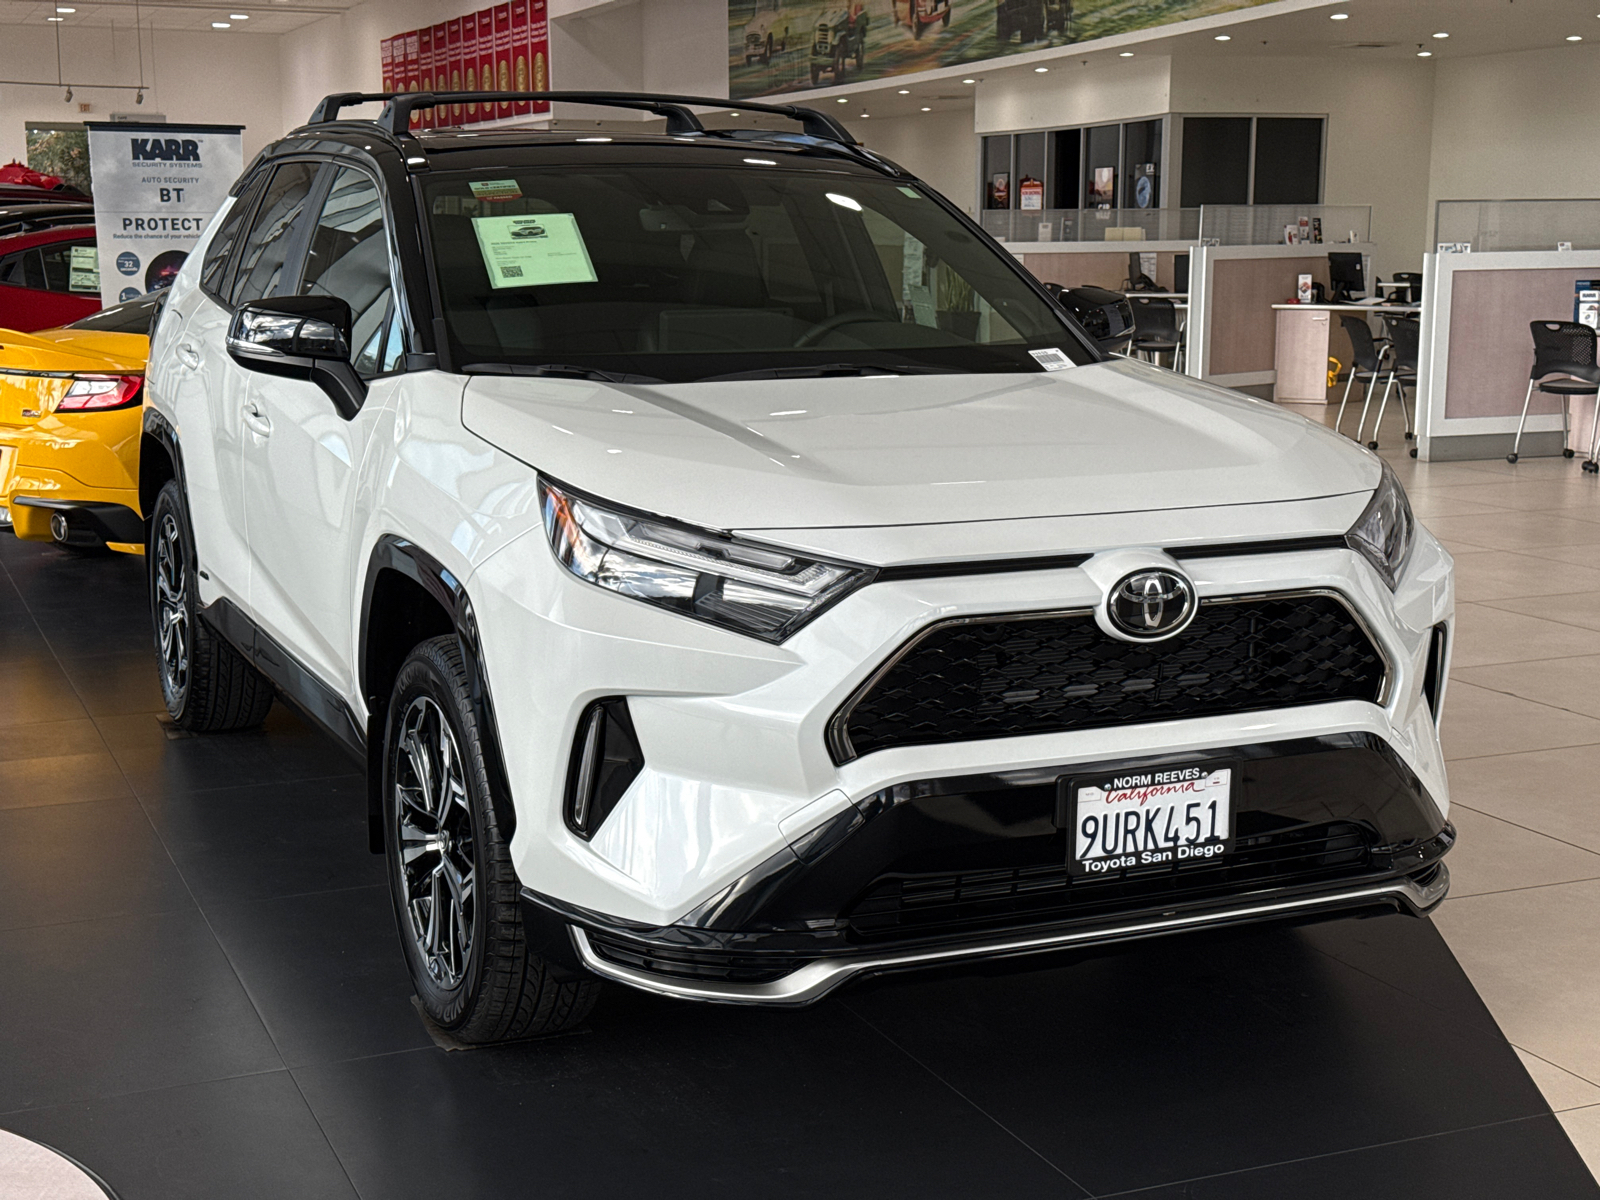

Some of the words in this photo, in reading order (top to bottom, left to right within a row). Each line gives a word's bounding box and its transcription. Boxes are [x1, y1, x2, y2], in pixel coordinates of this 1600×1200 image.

[131, 138, 201, 161] KARR
[142, 176, 162, 184] AUTO
[164, 176, 200, 184] SECURITY
[160, 187, 184, 203] BT
[122, 217, 203, 231] PROTECT
[124, 260, 133, 268] 32
[1113, 774, 1152, 789] NORM
[1154, 767, 1200, 784] REEVES
[1105, 781, 1206, 806] California
[1079, 800, 1220, 859] 9URK451
[1082, 854, 1136, 873] Toyota
[1141, 849, 1172, 864] San
[1177, 843, 1225, 859] Diego
